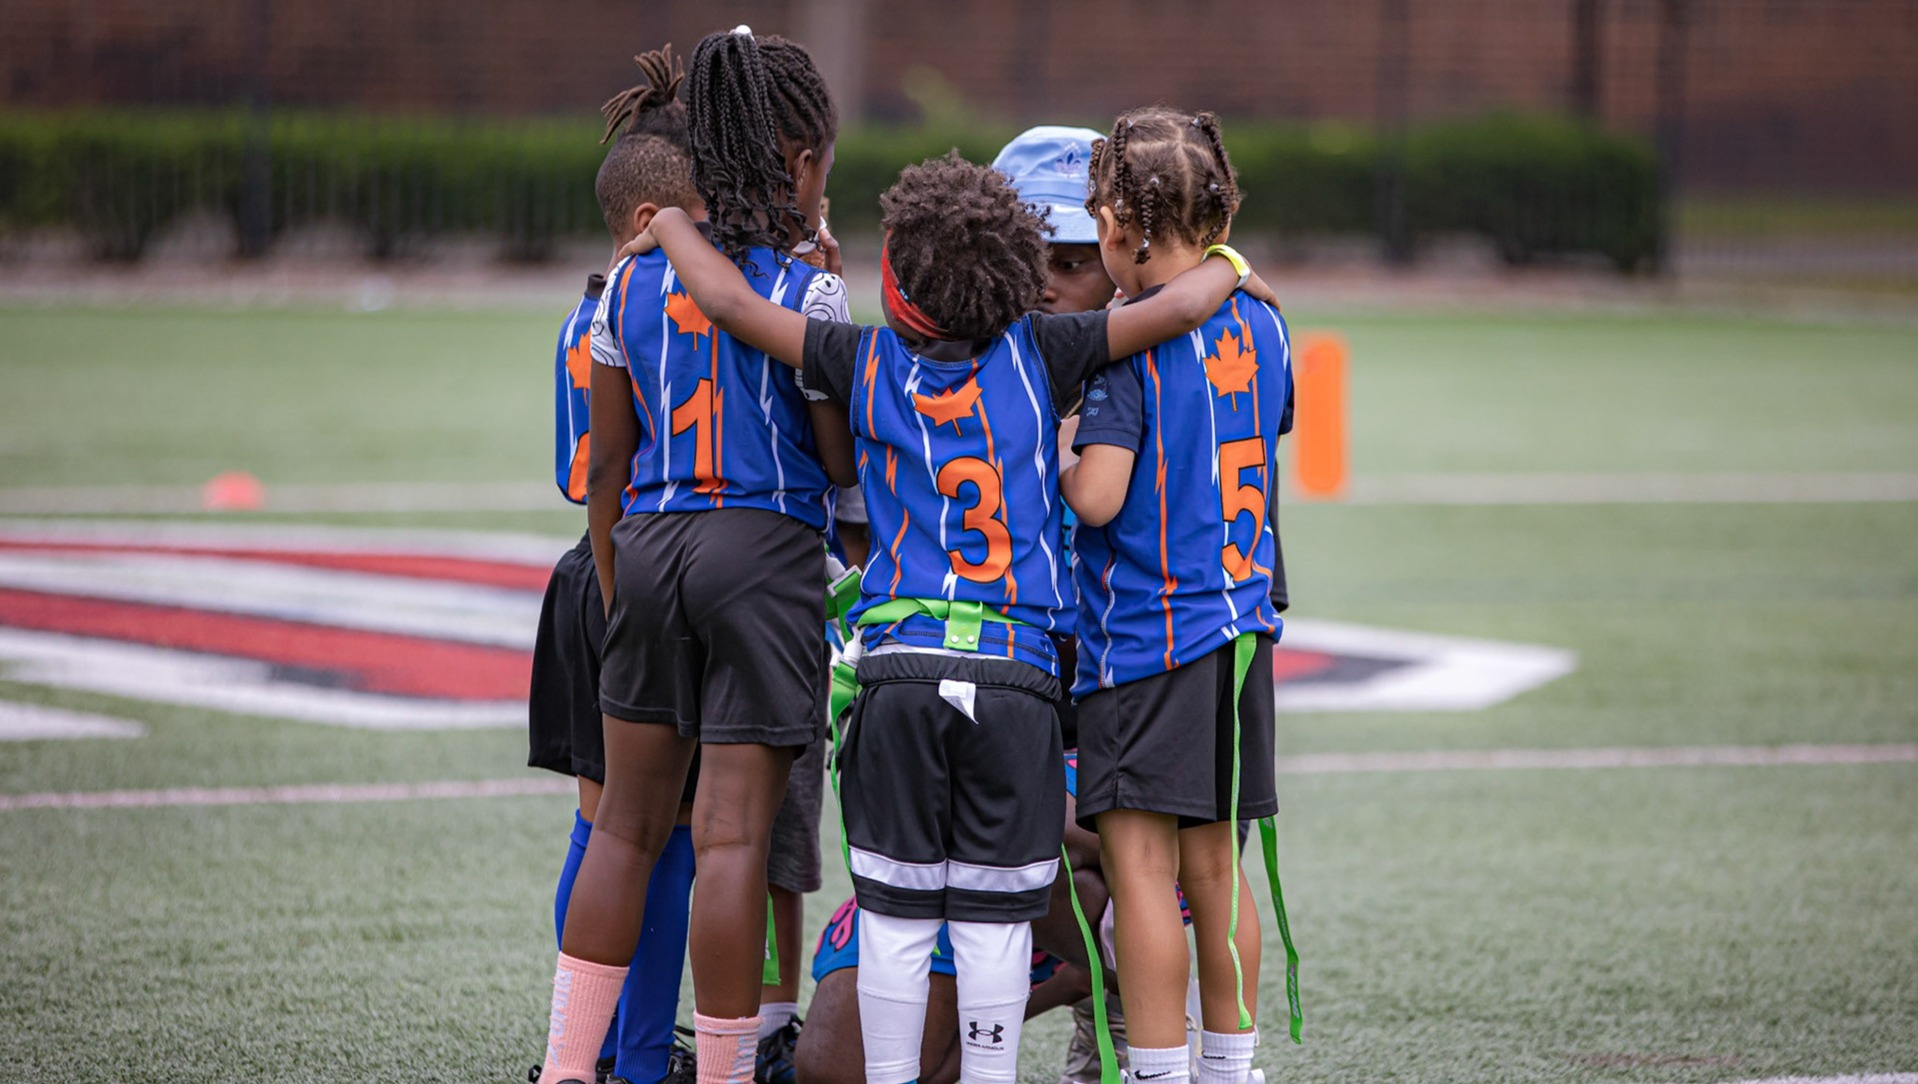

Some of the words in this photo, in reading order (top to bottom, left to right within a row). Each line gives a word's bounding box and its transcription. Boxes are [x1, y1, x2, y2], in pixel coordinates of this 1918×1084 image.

[671, 376, 720, 493] 1
[936, 456, 1013, 584] 3
[1219, 436, 1266, 582] 5
